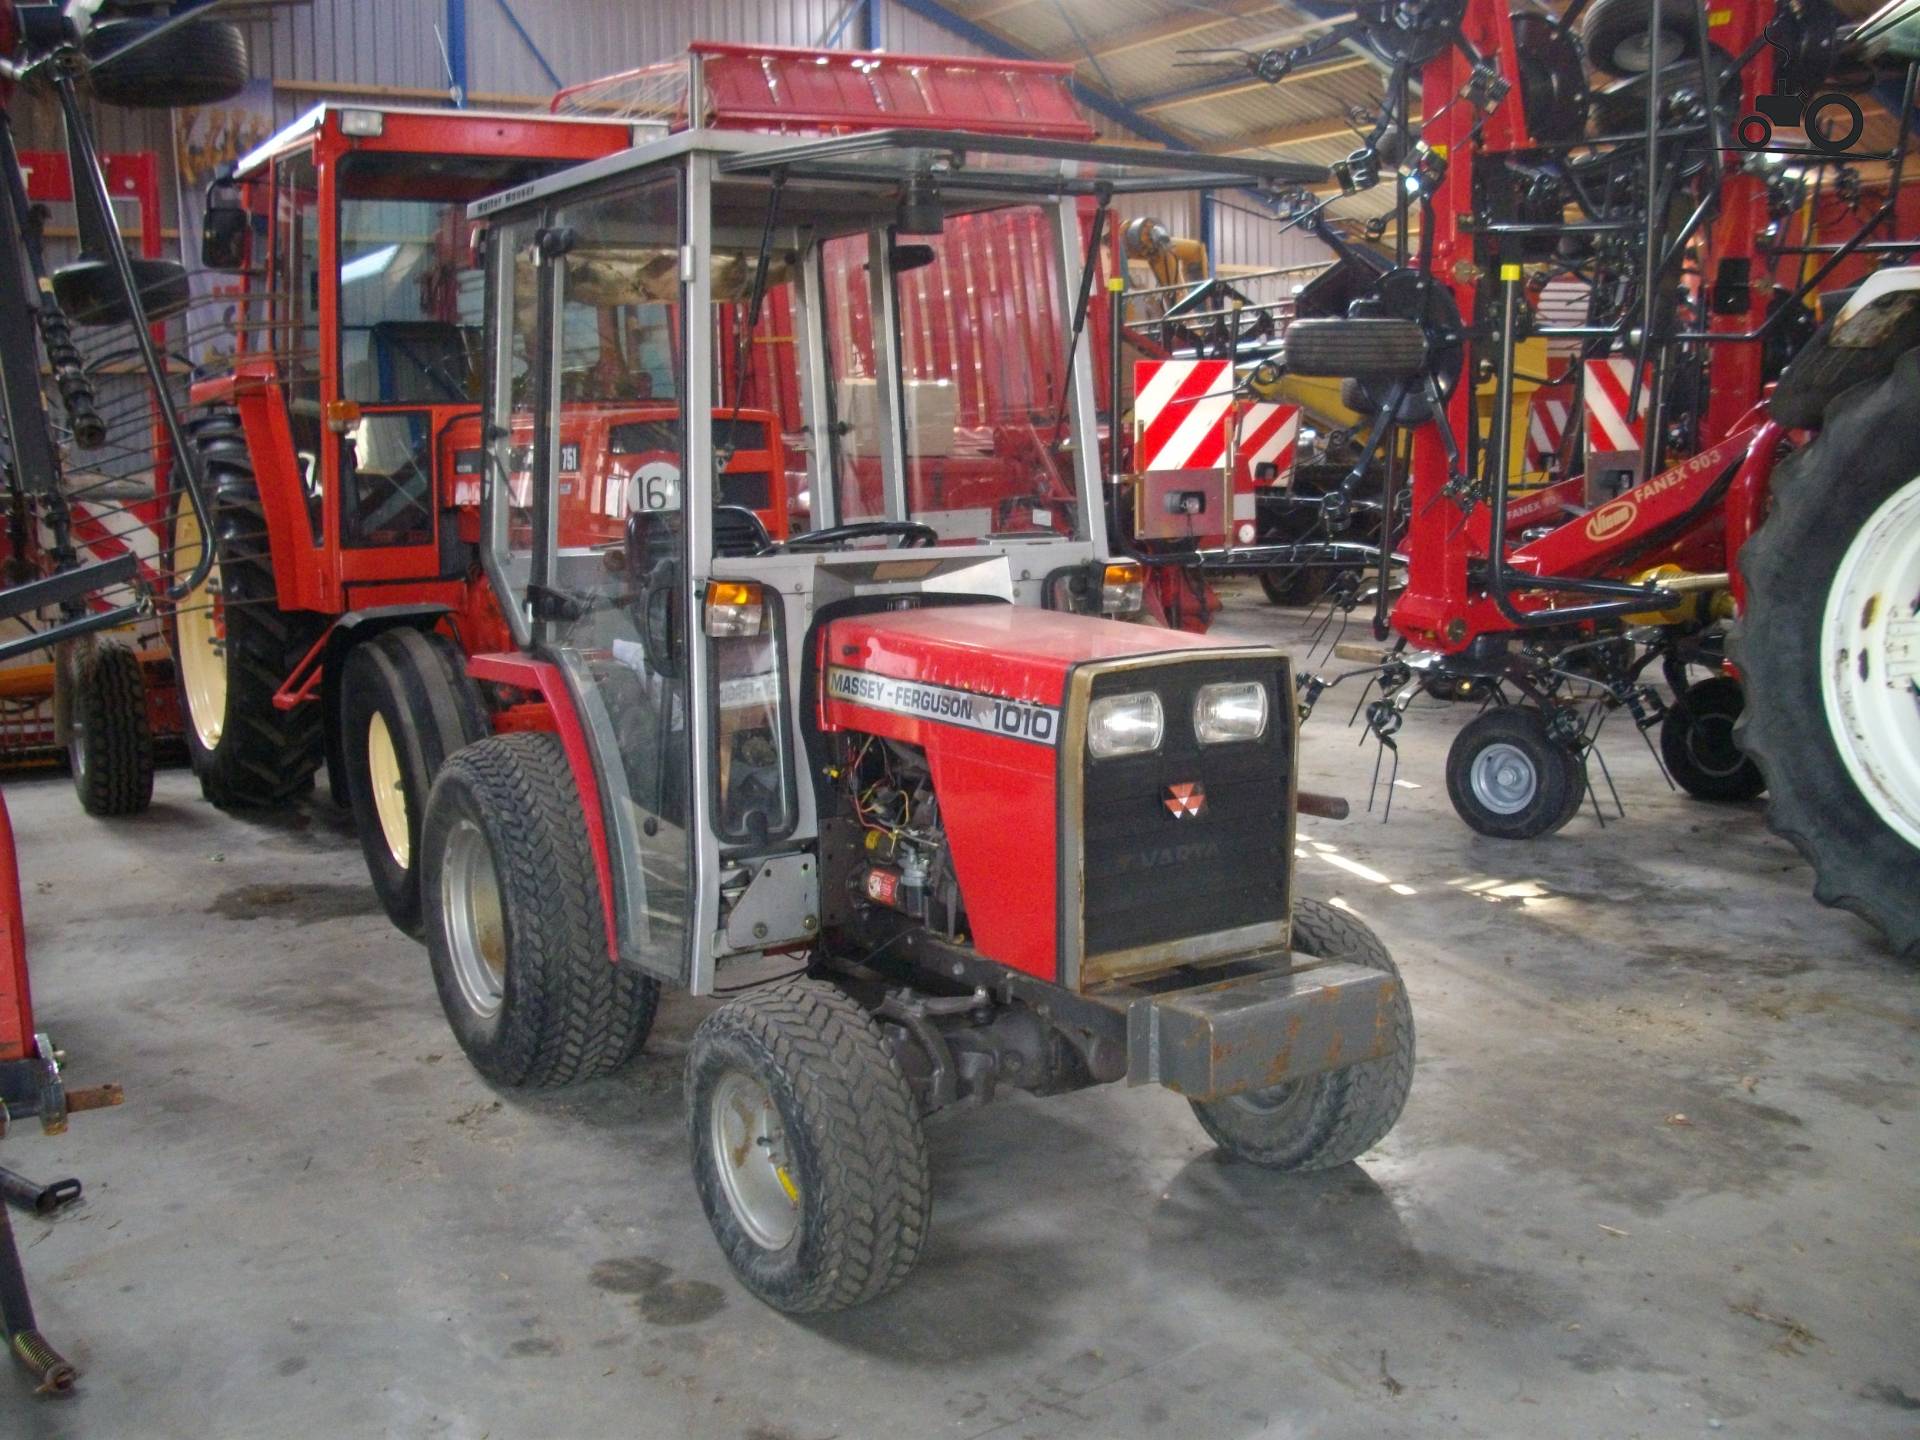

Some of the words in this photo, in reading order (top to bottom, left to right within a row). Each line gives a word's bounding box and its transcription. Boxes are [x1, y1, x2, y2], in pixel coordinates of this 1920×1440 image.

[1634, 466, 1688, 503] FANEX
[1689, 449, 1721, 473] 903
[992, 701, 1053, 740] 1010
